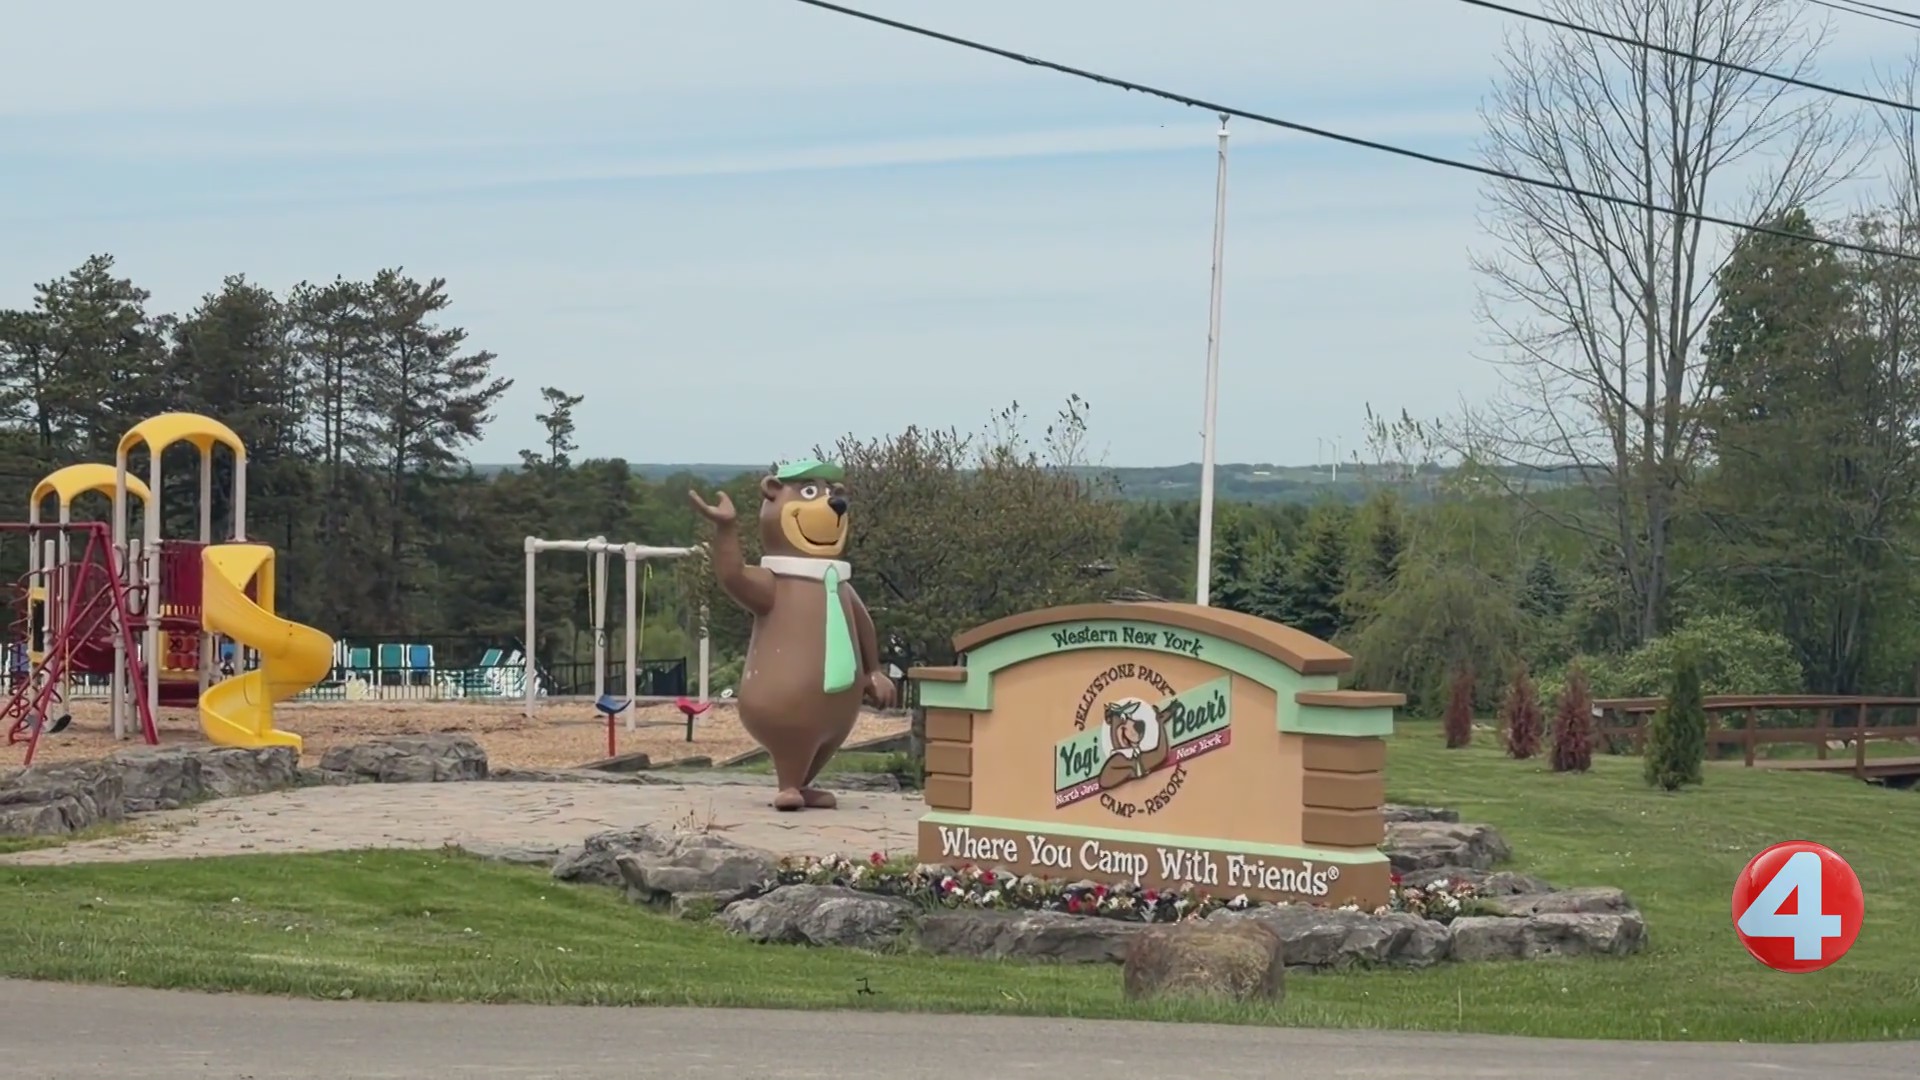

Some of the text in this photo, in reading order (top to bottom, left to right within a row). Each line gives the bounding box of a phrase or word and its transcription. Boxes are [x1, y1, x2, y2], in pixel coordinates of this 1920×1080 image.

[1052, 626, 1204, 657] Western New York
[1074, 663, 1135, 730] JELLYSTONE
[1060, 689, 1226, 777] Yogi Bear's
[1175, 734, 1222, 760] New York
[1056, 783, 1099, 805] North Java
[938, 826, 1018, 861] Where
[1025, 834, 1072, 869] You
[1079, 840, 1150, 886] Camp
[1156, 848, 1219, 884] With
